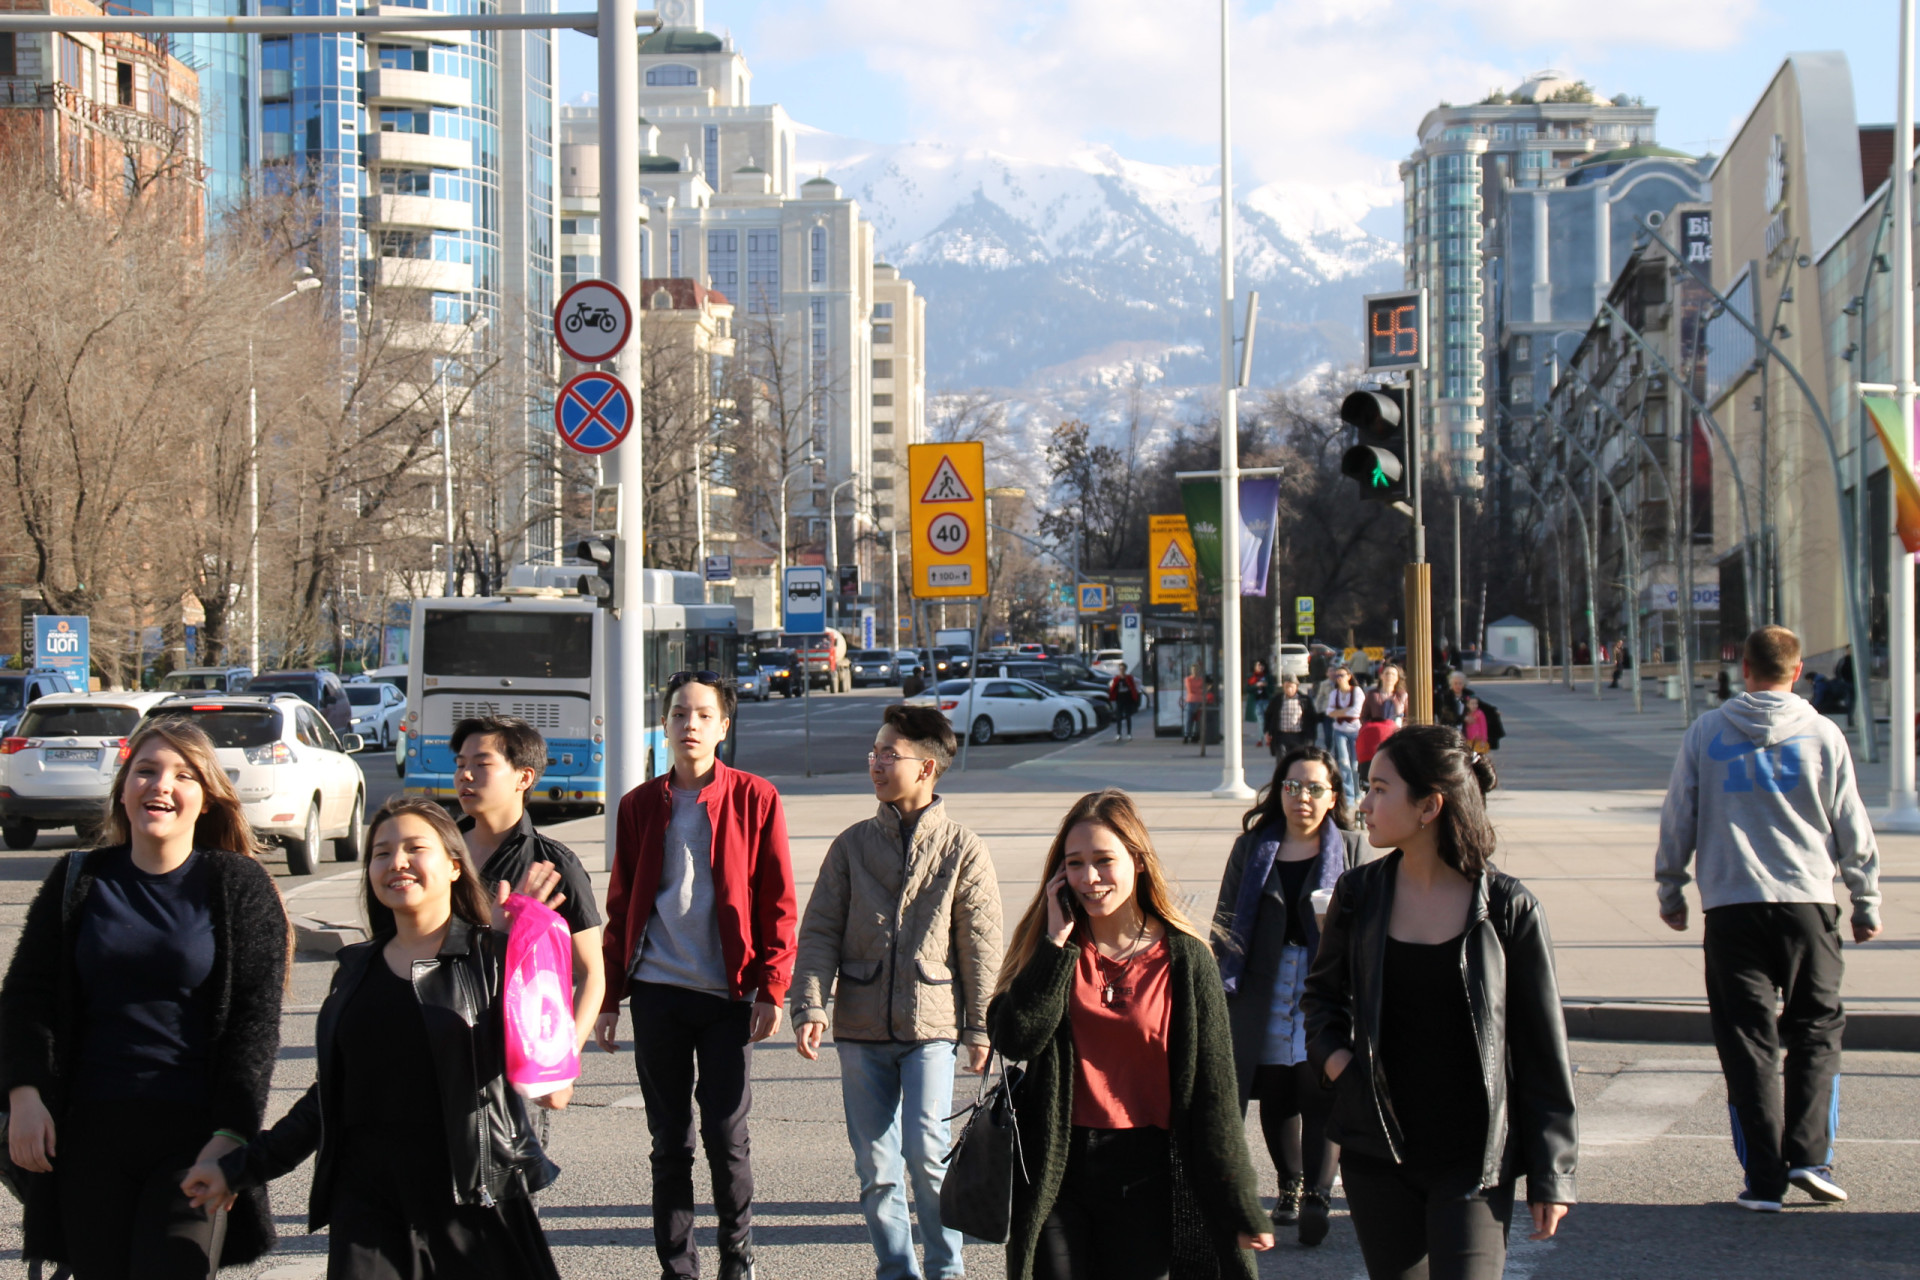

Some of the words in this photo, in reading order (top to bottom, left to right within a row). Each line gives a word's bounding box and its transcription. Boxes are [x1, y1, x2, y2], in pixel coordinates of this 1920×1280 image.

[1688, 217, 1712, 239] Бі
[1372, 305, 1418, 357] 45
[936, 524, 961, 542] 40
